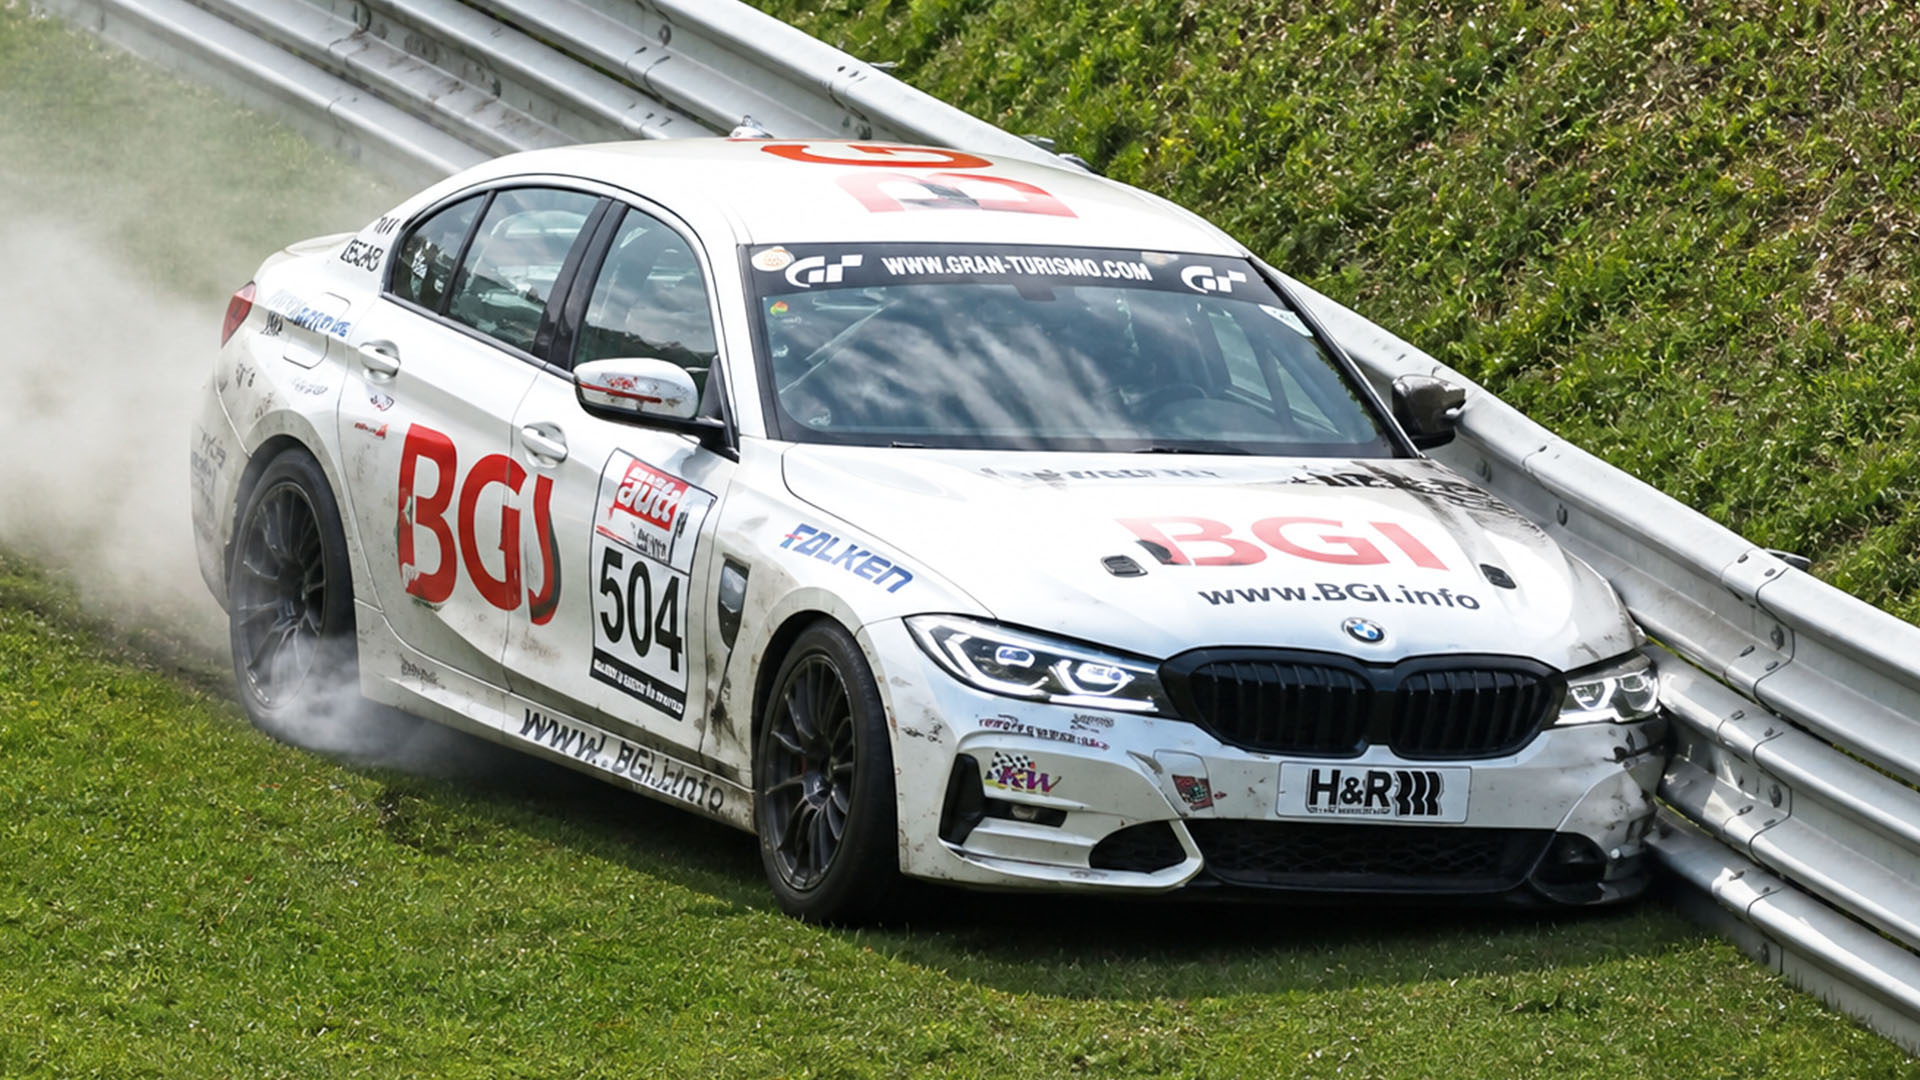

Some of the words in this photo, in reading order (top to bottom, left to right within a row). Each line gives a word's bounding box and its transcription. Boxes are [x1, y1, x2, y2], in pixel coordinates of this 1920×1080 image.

[882, 256, 1153, 282] WWW.GRAN-TURISMO.COM
[780, 523, 913, 594] FALKEN
[1115, 515, 1450, 571] BGI
[600, 546, 683, 673] 504
[1198, 582, 1481, 611] www.BGI.info
[1308, 769, 1393, 807] H&R
